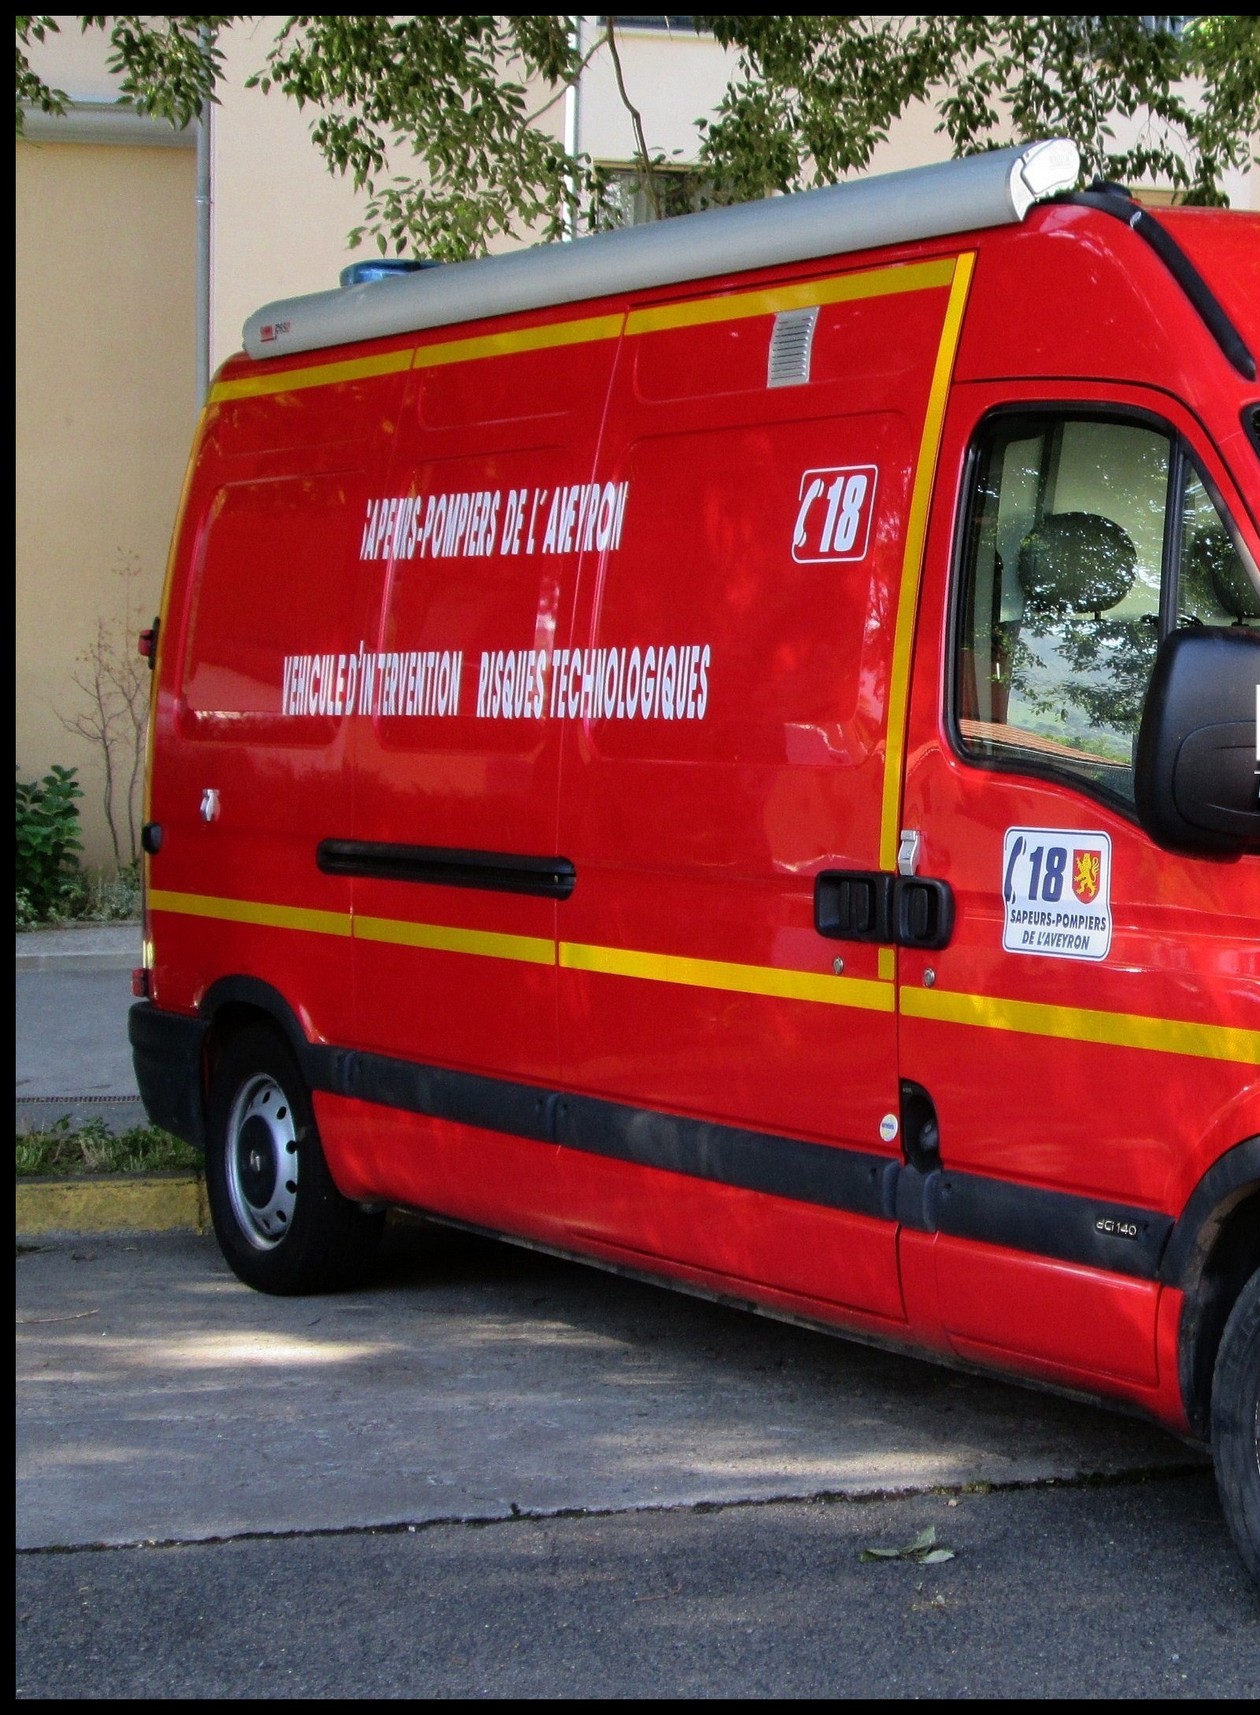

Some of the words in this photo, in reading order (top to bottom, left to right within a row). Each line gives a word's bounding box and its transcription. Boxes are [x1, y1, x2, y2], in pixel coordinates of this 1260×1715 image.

[501, 488, 528, 555] DE
[819, 474, 868, 553] 18
[476, 649, 546, 719] RISQUES
[550, 644, 711, 720] TECHNOLOGIQUES
[1028, 846, 1068, 902] 18
[1010, 909, 1107, 931] SAPEURS-POMPIERS
[1022, 930, 1036, 945] DE
[1037, 931, 1090, 950] L'AVEYRON
[1116, 1222, 1137, 1236] 140
